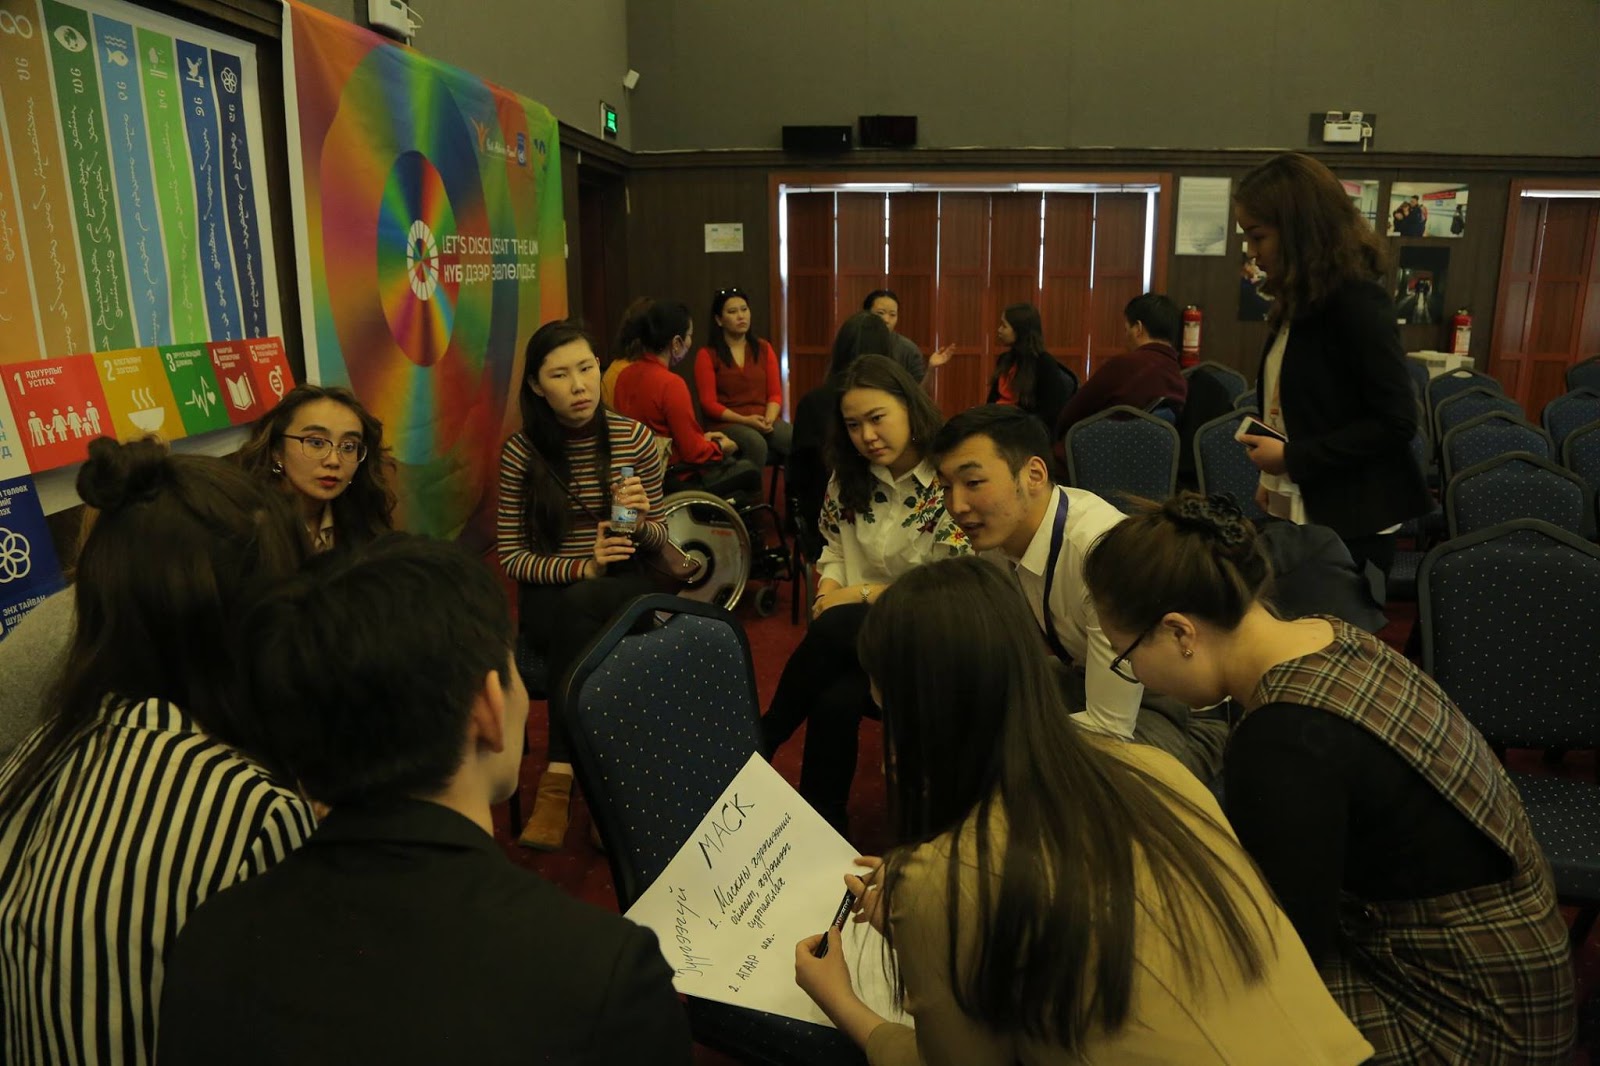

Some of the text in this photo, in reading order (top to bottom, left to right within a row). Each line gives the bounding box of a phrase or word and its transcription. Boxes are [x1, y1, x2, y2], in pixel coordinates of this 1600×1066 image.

[442, 236, 467, 254] LET'S
[511, 238, 528, 256] THE
[529, 239, 539, 256] UN
[165, 352, 177, 372] 3
[212, 348, 221, 366] 4
[249, 345, 257, 361] 5
[103, 360, 116, 382] 2
[14, 372, 26, 395] 1
[28, 378, 56, 388] УСТГАХ
[2, 606, 18, 617] ЭНХ
[698, 793, 755, 870] МАСК
[738, 954, 760, 981] АГААР
